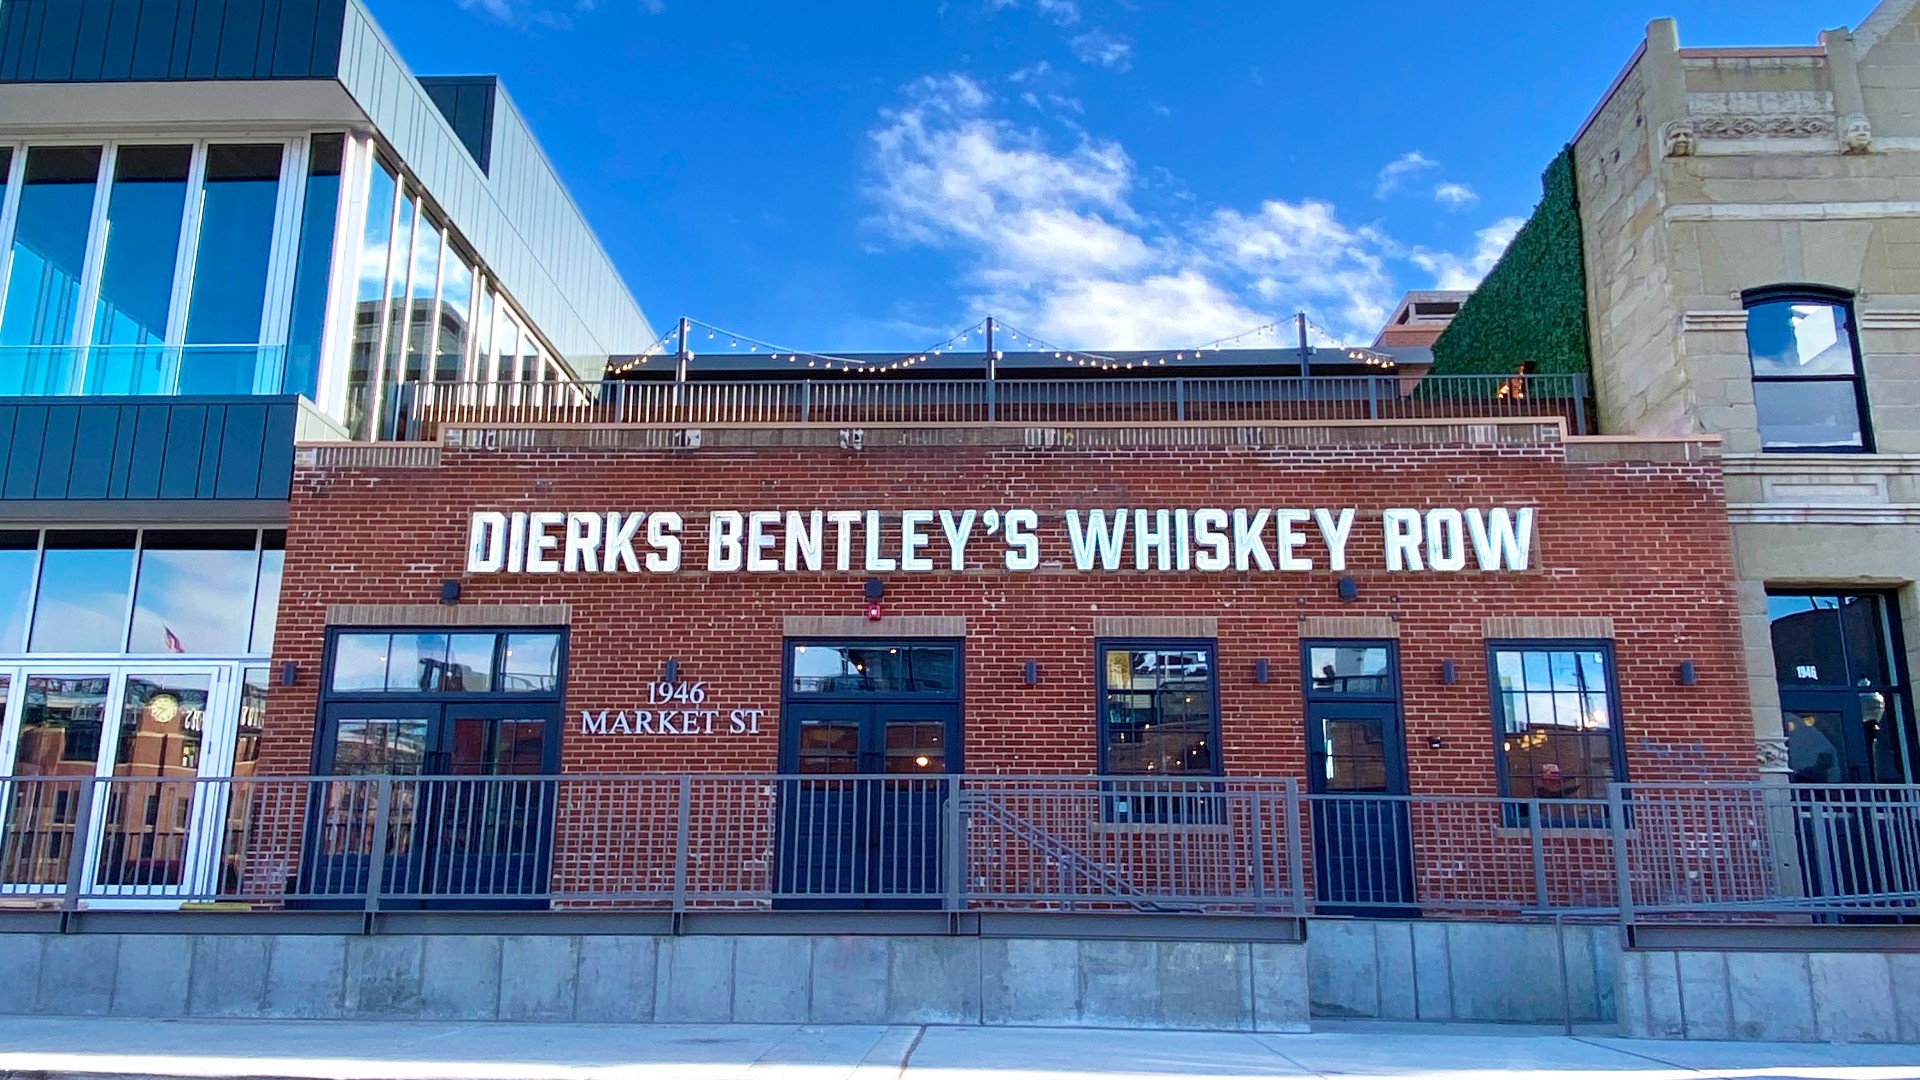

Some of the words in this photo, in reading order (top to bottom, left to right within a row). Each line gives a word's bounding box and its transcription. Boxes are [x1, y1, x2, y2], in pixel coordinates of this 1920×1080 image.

[466, 510, 683, 574] DIERKS
[706, 509, 1039, 573] BENTLEY'S
[1063, 506, 1354, 572] WHISKEY
[1382, 505, 1534, 572] ROW
[646, 681, 705, 706] 1946
[581, 709, 719, 735] MARKET
[730, 709, 765, 735] ST
